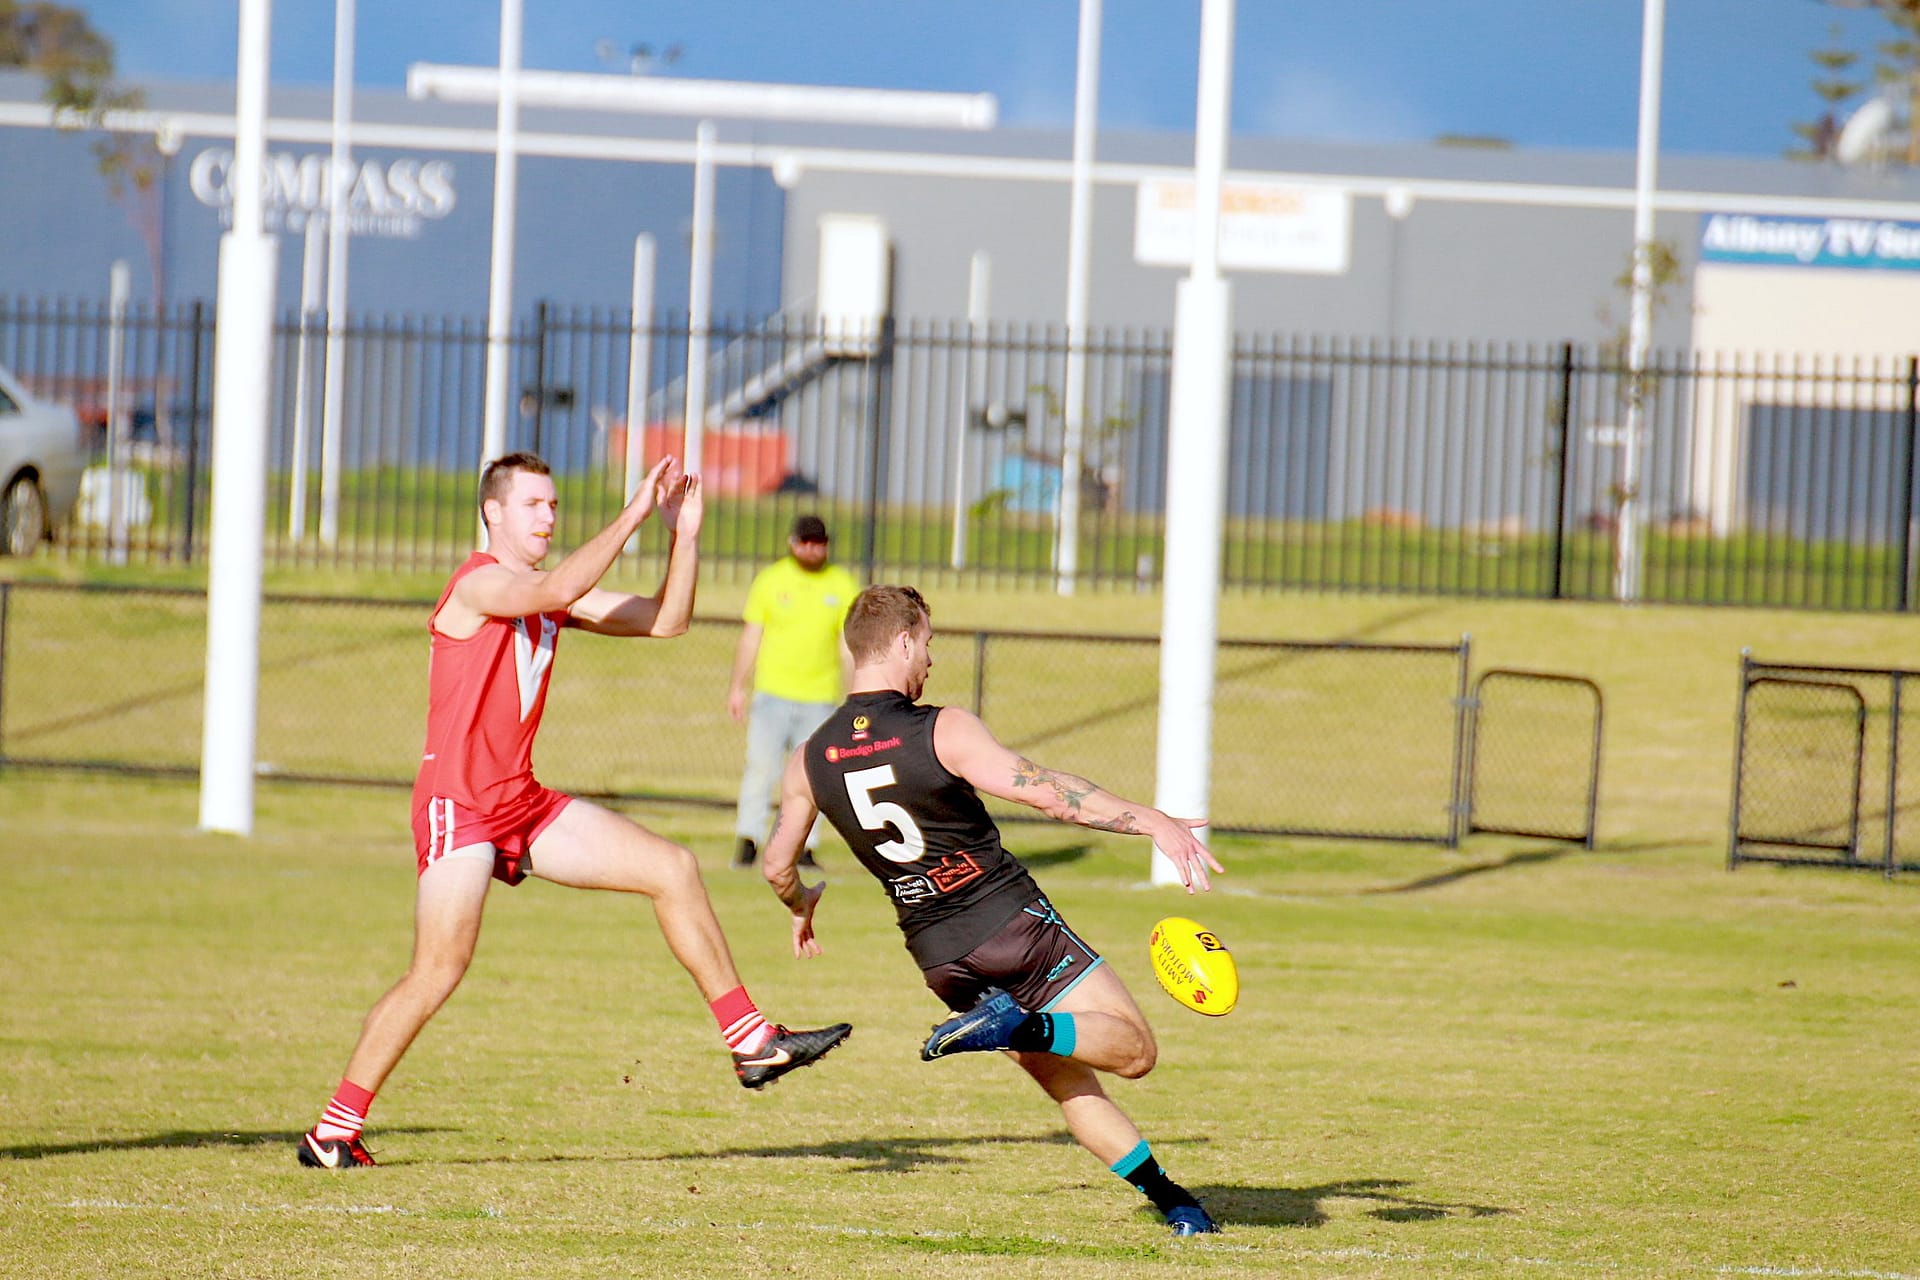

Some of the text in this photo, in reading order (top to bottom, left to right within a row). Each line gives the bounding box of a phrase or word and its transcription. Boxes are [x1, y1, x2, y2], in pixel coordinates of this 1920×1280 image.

[1703, 214, 1823, 262] Albany
[1824, 219, 1876, 257] TV
[839, 737, 900, 757] Bendigo Bank
[843, 764, 925, 863] 5
[1158, 953, 1184, 985] AMITY
[1161, 938, 1196, 983] MOTORS
